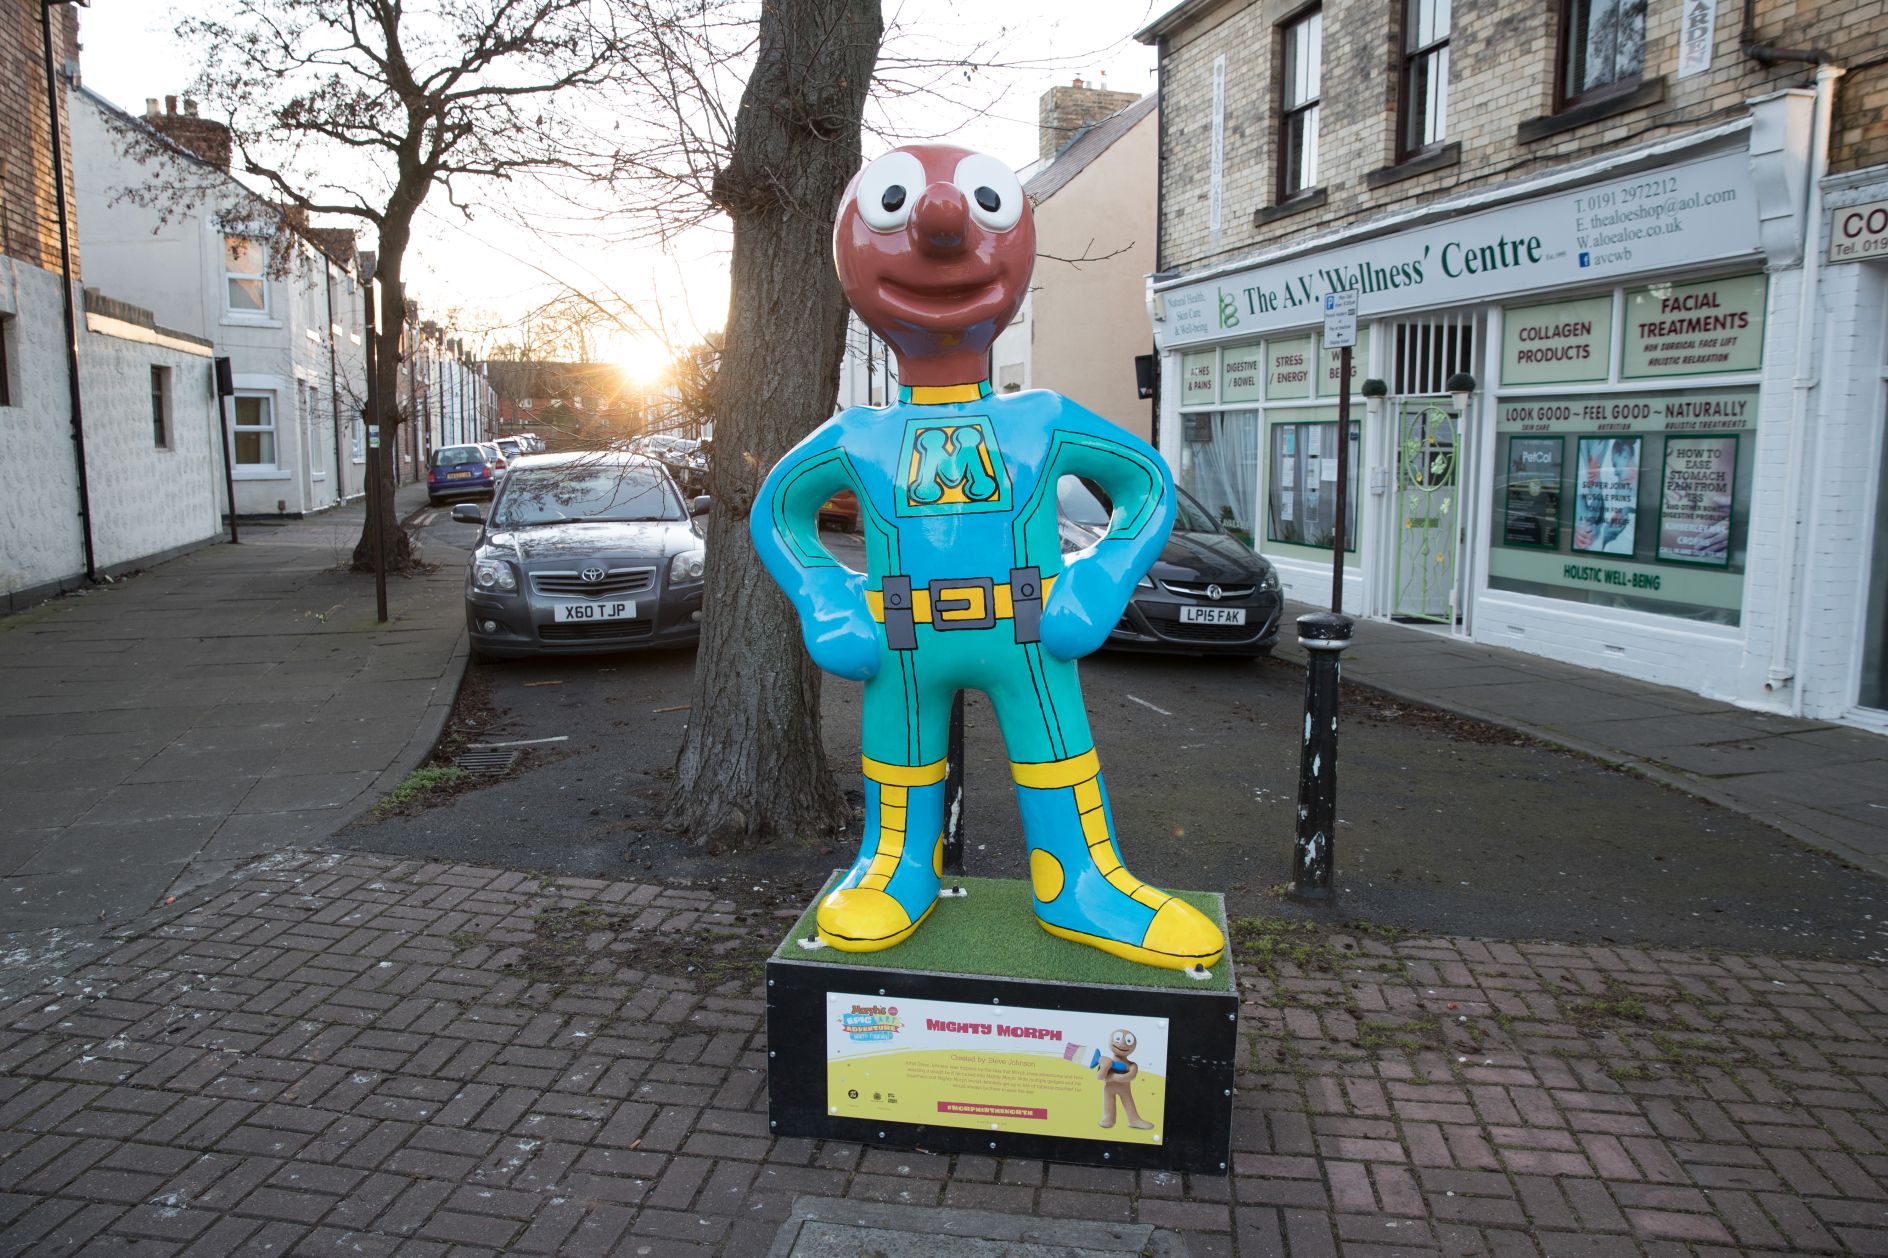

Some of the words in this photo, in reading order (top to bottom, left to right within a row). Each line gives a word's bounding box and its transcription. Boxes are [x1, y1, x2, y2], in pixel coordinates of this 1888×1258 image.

[1687, 0, 1711, 68] ARDEN
[1587, 188, 1616, 211] 0191
[1621, 177, 1678, 203] 2972212
[1590, 186, 1736, 231] thealoeshop@aol.com
[1835, 242, 1858, 256] Tel.
[1594, 248, 1632, 266] avcwb
[1243, 287, 1278, 315] The
[1283, 275, 1320, 308] A.V.
[1441, 234, 1543, 278] Centre
[1661, 292, 1721, 314] FACIAL
[1519, 321, 1592, 342] COLLAGEN
[1638, 311, 1749, 339] TREATMENTS
[1698, 338, 1719, 348] FACE
[1720, 337, 1738, 347] LIFT
[1275, 354, 1304, 367] STRESS
[1517, 344, 1591, 364] PRODUCTS
[1226, 360, 1257, 373] DIGESTIVE
[1329, 365, 1357, 380] BEG
[1233, 376, 1256, 388] BOWEL
[1277, 370, 1308, 384] ENERGY
[1194, 380, 1212, 391] PAINS
[1506, 407, 1534, 422] LOOK
[1537, 406, 1571, 421] GOOD
[1583, 405, 1607, 420] FEEL
[1612, 403, 1650, 419] GOOD
[1665, 400, 1748, 419] NATURALLY
[1699, 419, 1747, 429] TREATMENTS
[1676, 449, 1704, 459] HOW
[1706, 449, 1721, 459] TO
[1685, 460, 1712, 470] EASE
[1670, 470, 1726, 481] STOMACH
[1695, 482, 1728, 493] FROM
[1563, 564, 1602, 583] HOLISTIC
[1604, 570, 1661, 590] WELL-BEING
[565, 604, 593, 618] X60
[597, 603, 626, 618] TJP
[1187, 608, 1215, 622] LP15
[1218, 609, 1240, 623] FAK
[926, 1018, 992, 1035] MIGHTY
[997, 1024, 1063, 1042] MORPH
[950, 1054, 976, 1064] Created
[978, 1056, 986, 1066] by
[988, 1057, 1007, 1066] Steve
[1007, 1058, 1036, 1069] Johnson
